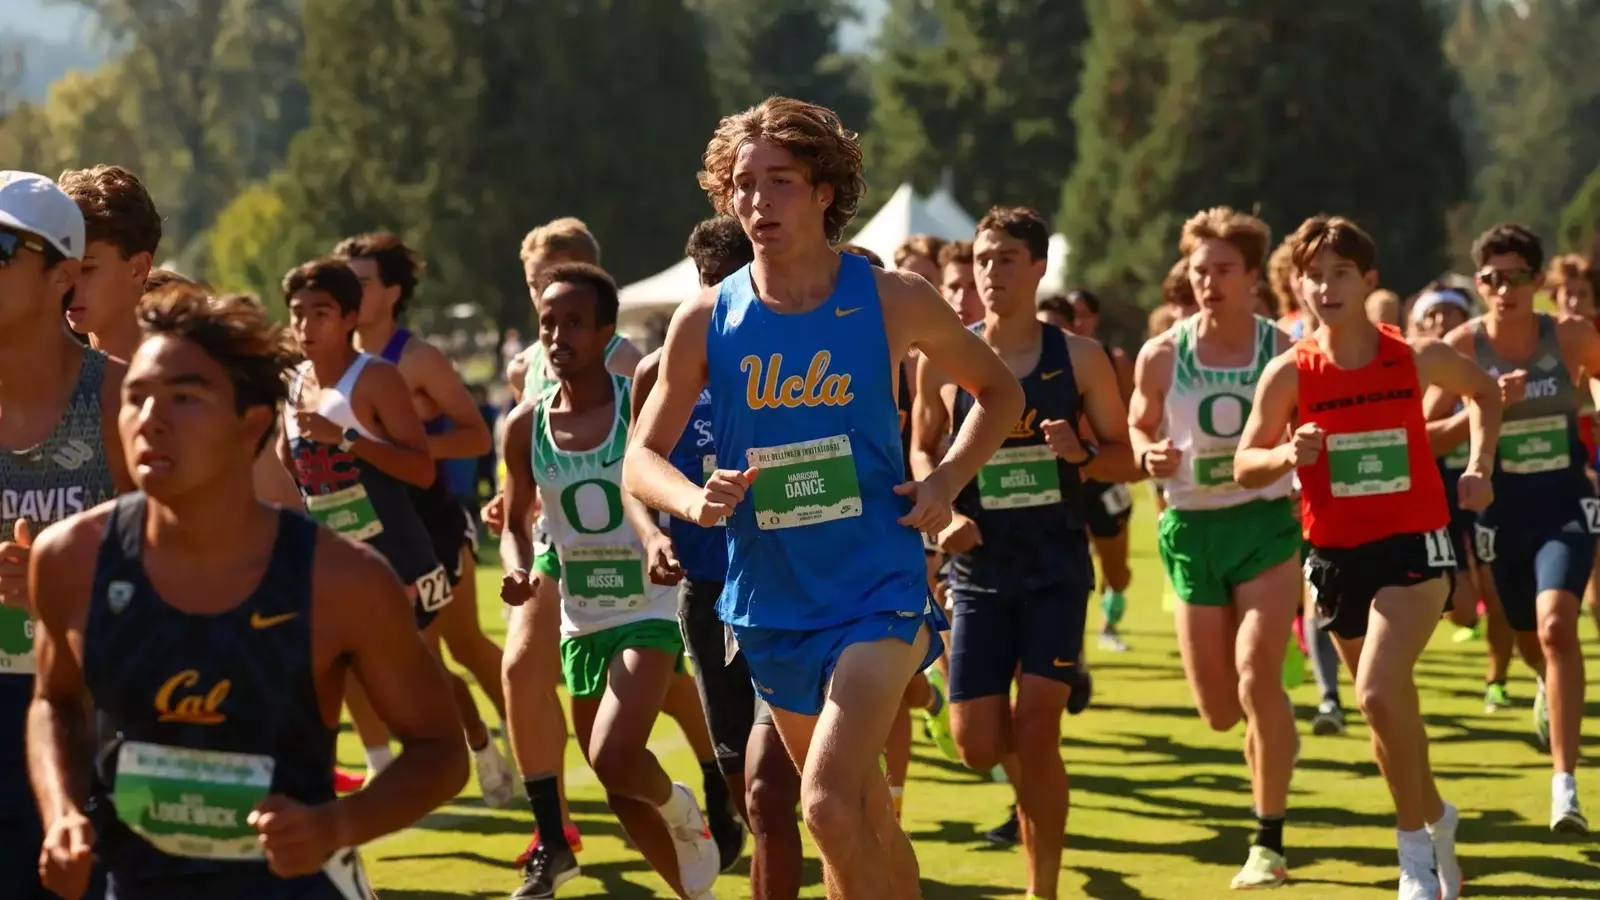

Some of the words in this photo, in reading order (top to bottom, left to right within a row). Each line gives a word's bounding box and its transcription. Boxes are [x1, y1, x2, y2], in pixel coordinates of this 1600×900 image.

[740, 350, 855, 410] Ucla
[1524, 376, 1558, 400] AVIS
[758, 453, 771, 463] BILL
[771, 449, 801, 461] DELLINGER
[784, 478, 826, 499] DANCE
[787, 470, 820, 483] HARRISON
[2, 485, 84, 522] DAVIS
[560, 478, 624, 534] O
[586, 574, 624, 588] HUSSEIN
[154, 669, 231, 724] Cal
